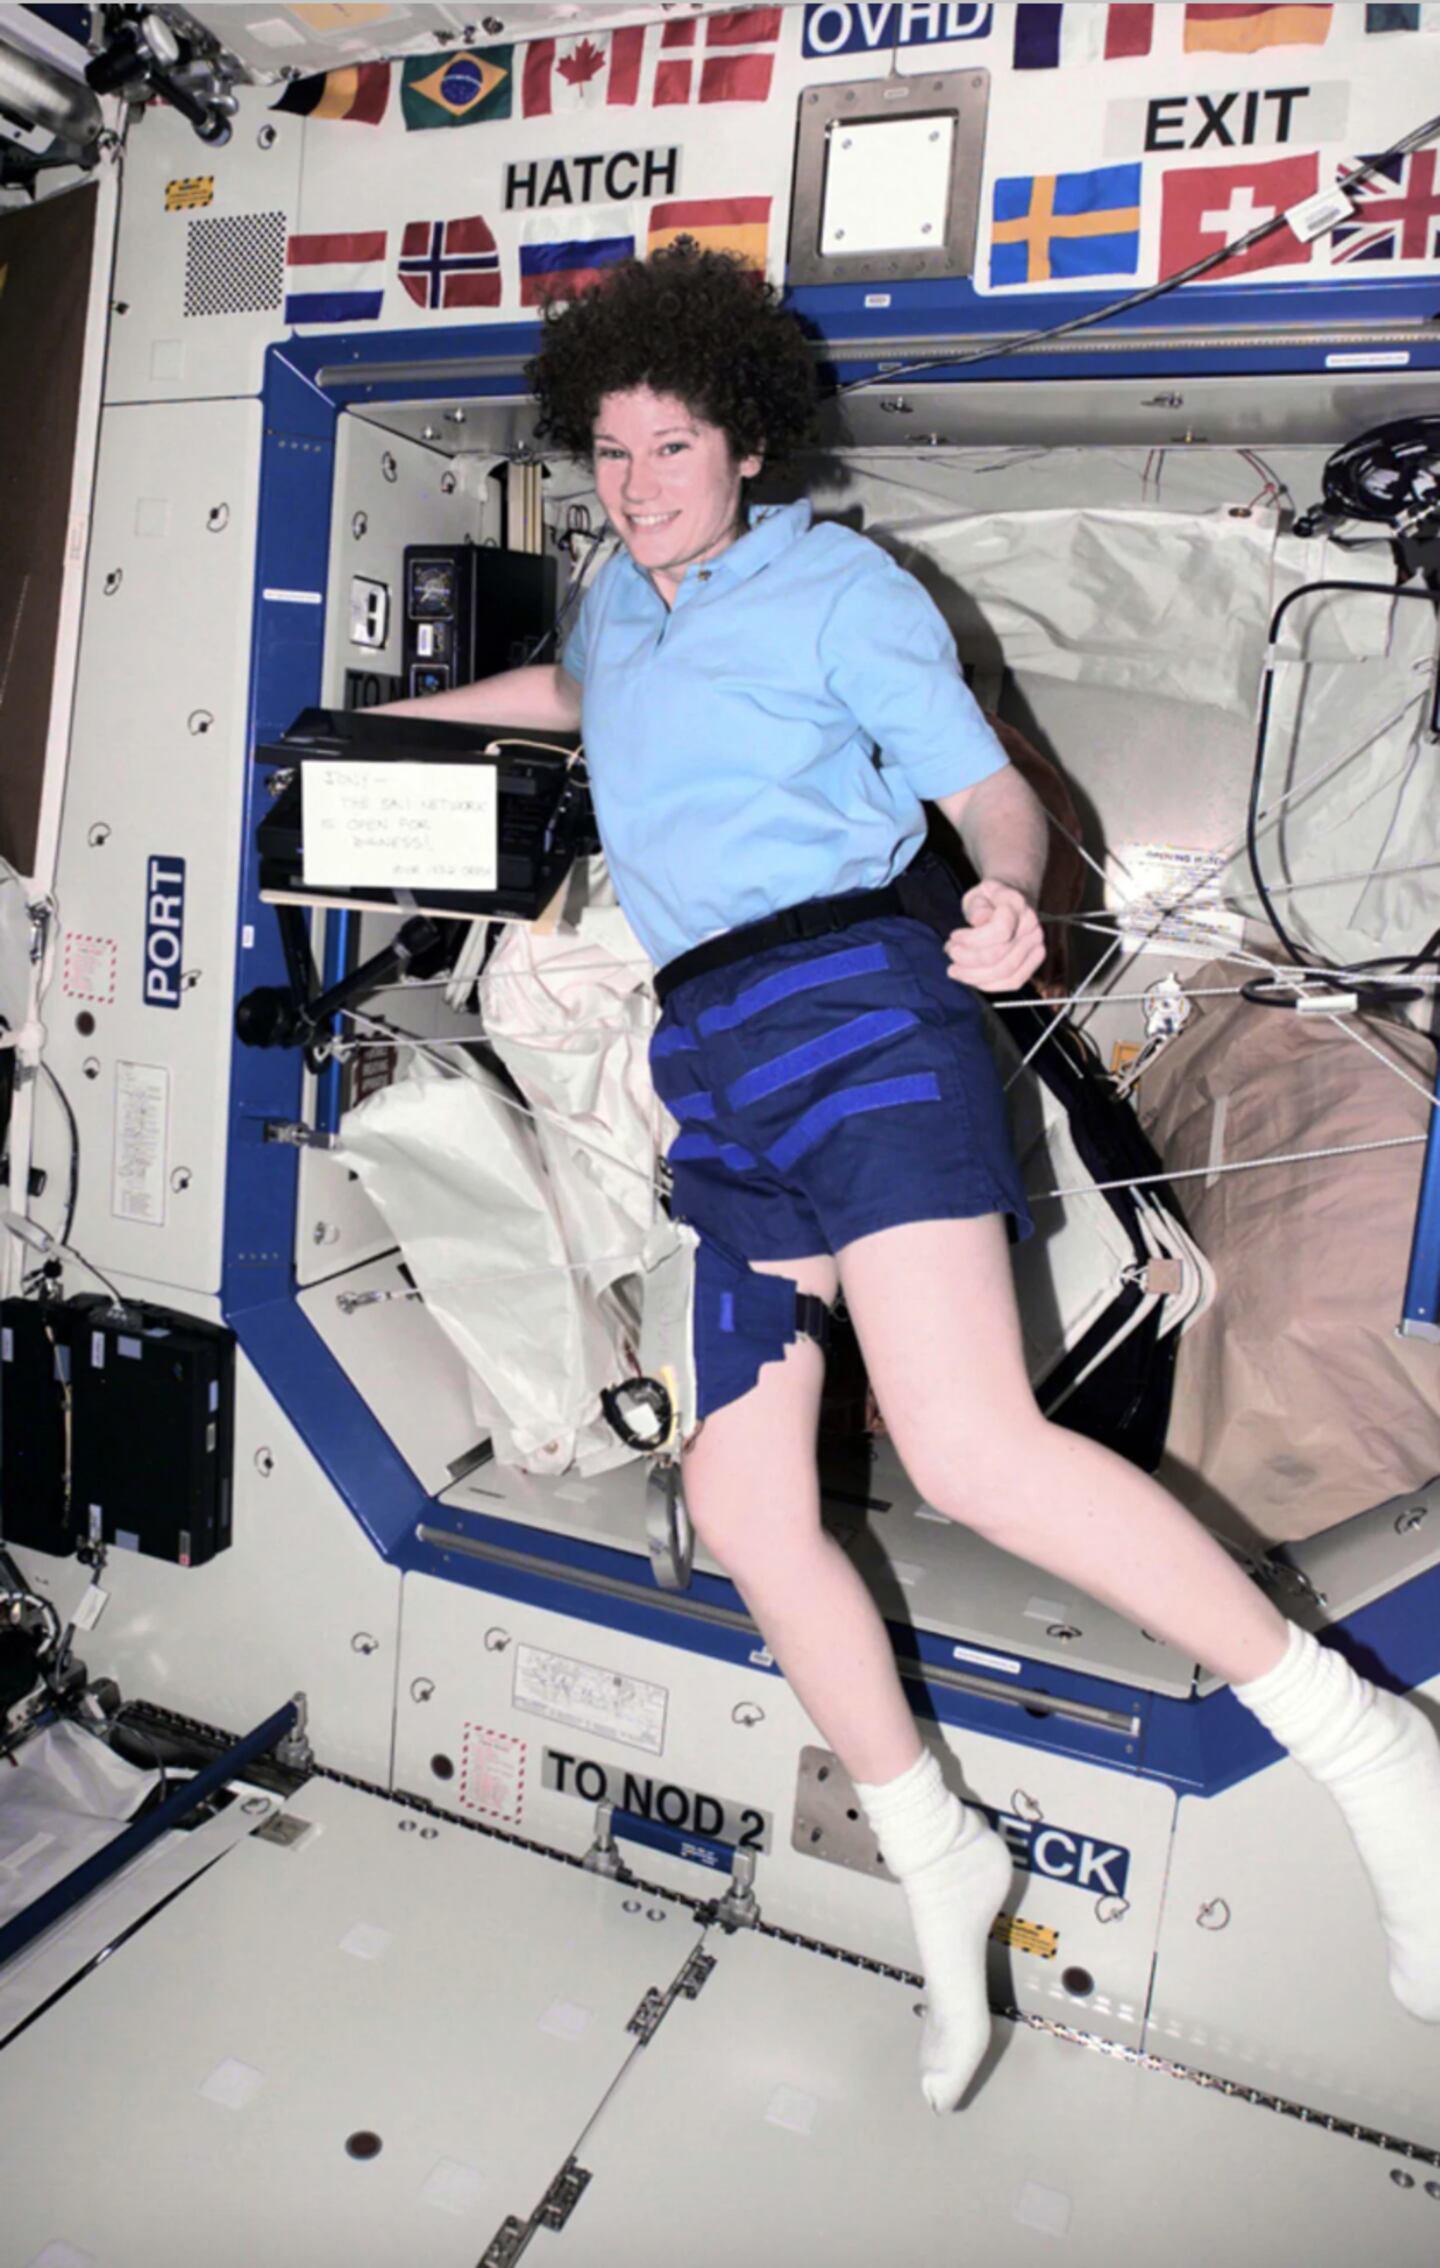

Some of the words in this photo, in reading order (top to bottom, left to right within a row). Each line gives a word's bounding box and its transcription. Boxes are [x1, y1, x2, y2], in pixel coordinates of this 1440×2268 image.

[808, 3, 989, 53] OVHD
[1144, 86, 1310, 152] EXIT
[505, 147, 677, 210] HATCH
[348, 673, 380, 709] TO
[147, 860, 182, 1002] PORT
[547, 1750, 608, 1803] TO
[622, 1772, 724, 1838] NOD
[738, 1809, 764, 1852] 2
[996, 1815, 1123, 1895] ECK
